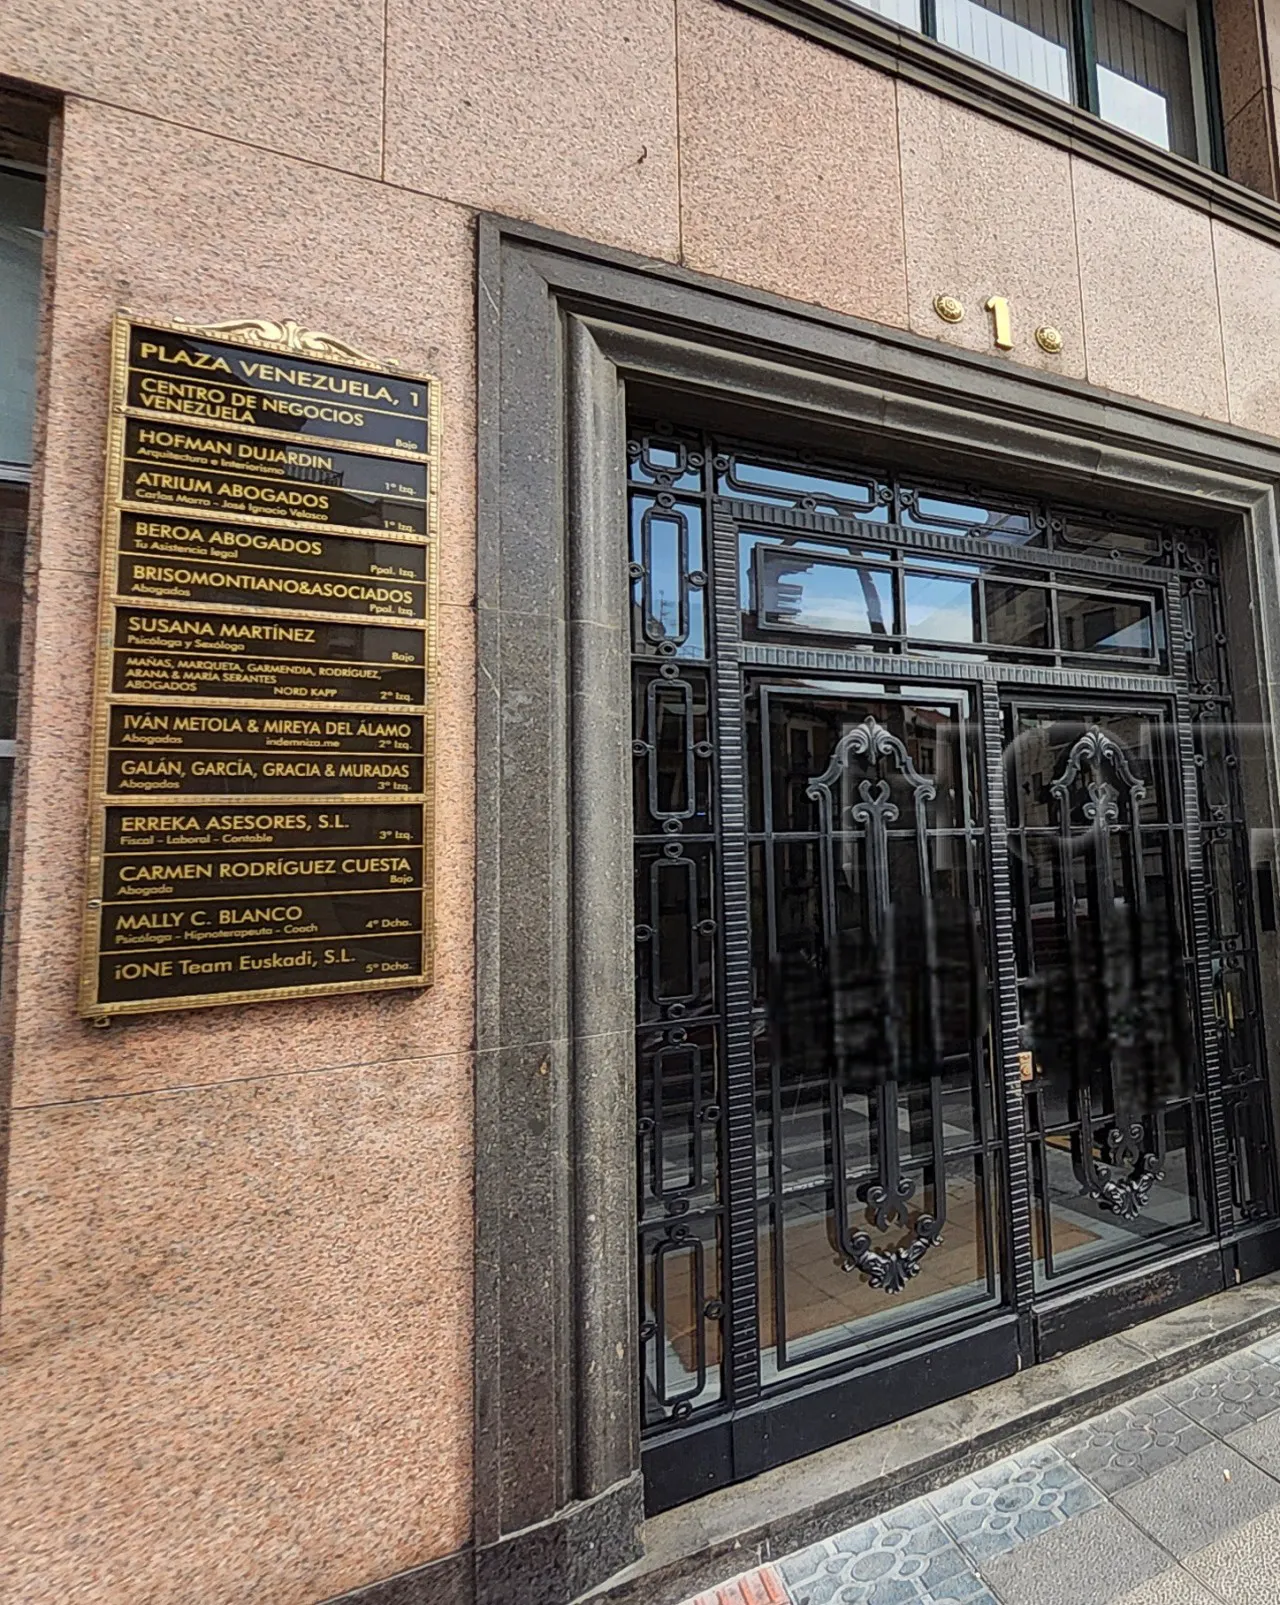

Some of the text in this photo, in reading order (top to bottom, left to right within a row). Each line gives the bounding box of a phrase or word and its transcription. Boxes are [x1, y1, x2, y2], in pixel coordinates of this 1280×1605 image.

[984, 295, 1014, 350] 1
[141, 342, 419, 407] PLAZA VENEZUELA, 1
[139, 392, 256, 424] VENEZUELA
[141, 377, 365, 427] CENTRO DE NEGOCIOS
[138, 429, 333, 470] HOFMAN DUJARDIN
[394, 438, 418, 450] Bajo
[136, 447, 209, 464] Arquitectura
[220, 458, 285, 475] Interiorismo
[135, 472, 330, 509] ATRIUM ABOGADOS
[135, 488, 174, 502] Carlos
[221, 499, 246, 511] José
[248, 502, 288, 516] Ignacio
[289, 507, 329, 521] Velasco
[133, 539, 149, 549] Tu
[150, 541, 208, 555] Asistencia
[135, 521, 323, 556] BEROA ABOGADOS
[130, 583, 192, 597] Abogados
[132, 564, 413, 605] BRISOMONTIANO&ASOCIADOS
[127, 616, 317, 644] SUSANA MARTÍNEZ
[127, 634, 246, 652] Psicóloga y Sexóloga
[125, 655, 382, 681] MAÑAS, MARQUETA, GARMENDIA, RODRÍGUEZ,
[391, 651, 416, 663] Bajo
[124, 668, 278, 685] ARANA & MARÍA SERANTES
[124, 679, 198, 692] ABOGADOS
[273, 686, 338, 698] NORD KAPP
[123, 711, 412, 738] IVÁN METOLA & MIREYA DEL ÁLAMO
[121, 733, 184, 746] Abogados
[121, 757, 410, 779] GALÁN, GARCÍA, GRACIA & MURADAS
[118, 779, 181, 791] Abogados
[121, 813, 350, 832] ERREKA ASESORES, S.L.
[120, 835, 155, 846] Fiscal
[166, 833, 211, 845] Laboral
[222, 833, 274, 844] Contable
[119, 856, 412, 882] CARMEN RODRÍGUEZ CUESTA
[389, 873, 414, 885] Bajo
[116, 883, 174, 896] Abogada
[115, 905, 303, 930] MALLY C. BLANCO
[184, 926, 273, 942] Hipnoterapeuta
[283, 923, 319, 934] Coach
[114, 947, 356, 980] iONE Team Euskadi, S.L.
